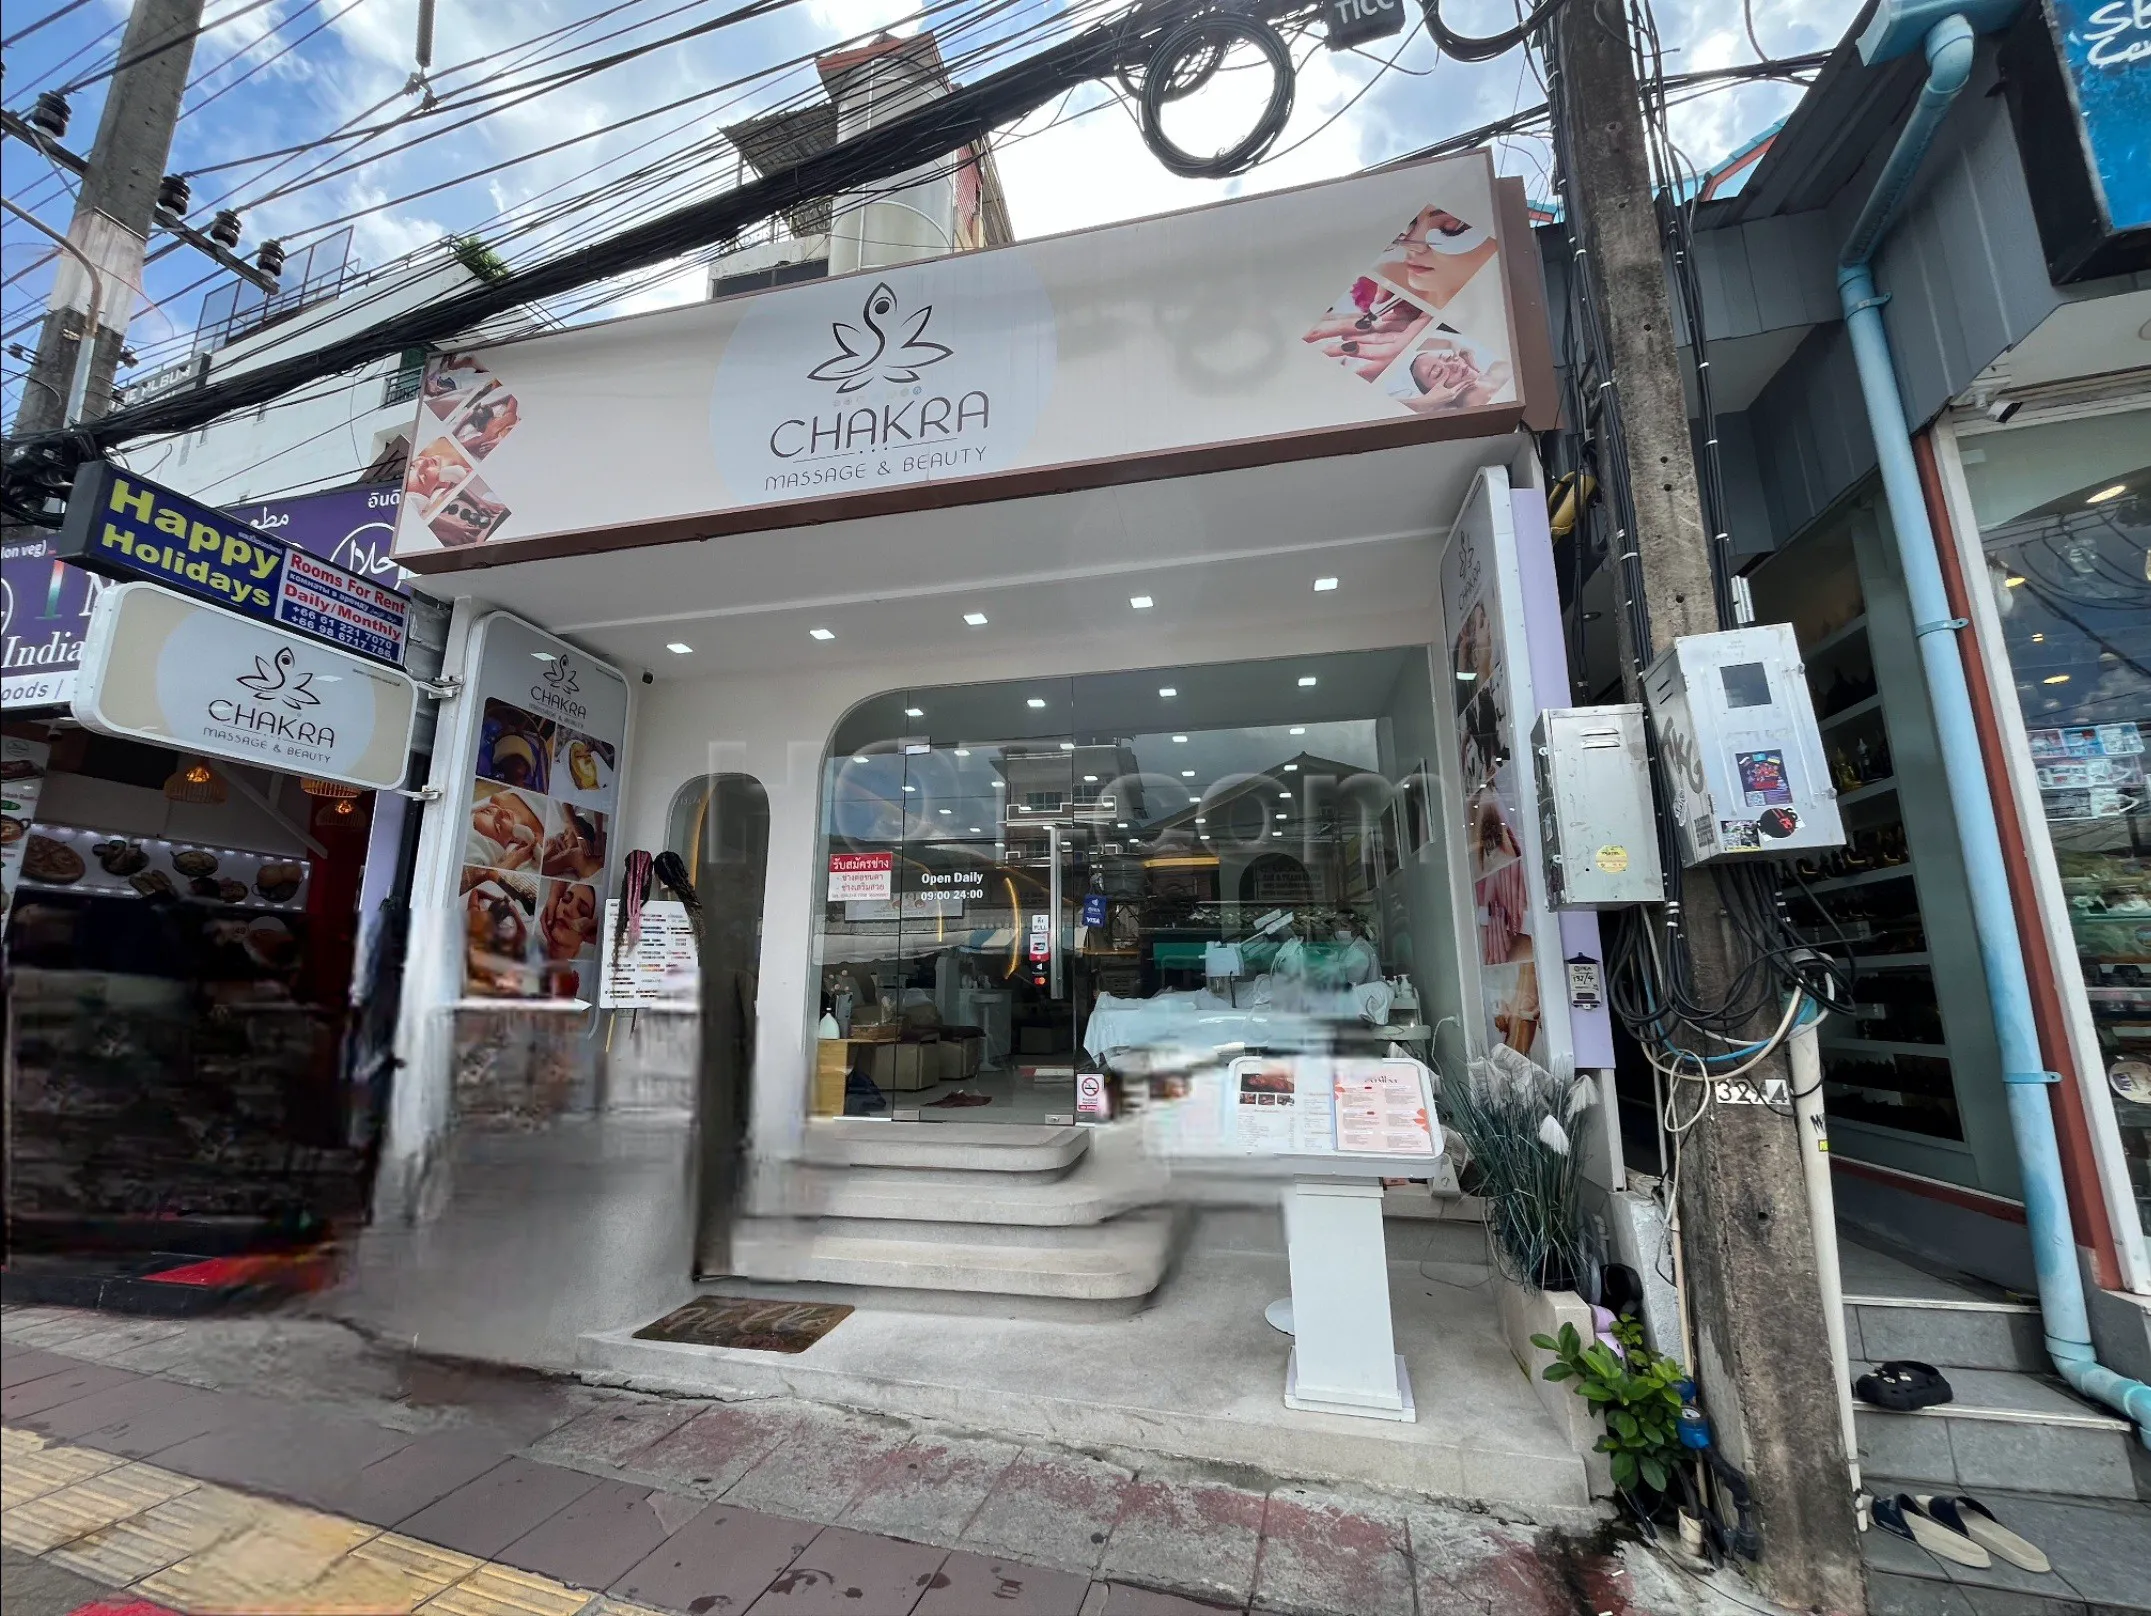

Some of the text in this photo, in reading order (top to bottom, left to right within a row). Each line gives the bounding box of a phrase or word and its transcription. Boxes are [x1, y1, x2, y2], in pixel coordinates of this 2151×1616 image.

[769, 390, 989, 458] CHAKRA
[764, 445, 988, 491] MASSAGE & BEAUTY
[22, 540, 47, 558] veg)
[109, 479, 280, 579] Happy
[102, 524, 271, 607] Holidays
[291, 553, 406, 614] Rooms For Rent
[292, 605, 392, 649] +66 61 221 7070
[292, 615, 315, 629] +66
[319, 624, 334, 637] 98
[338, 632, 368, 649] 6717
[530, 686, 587, 720] CHAKRA
[208, 699, 335, 749] CHAKRA
[203, 727, 332, 764] MASSAGE & BEAUTY
[833, 856, 889, 870] รับสมัครช่าง
[921, 872, 984, 886] Open Daily
[920, 889, 984, 901] 09:00 24:00
